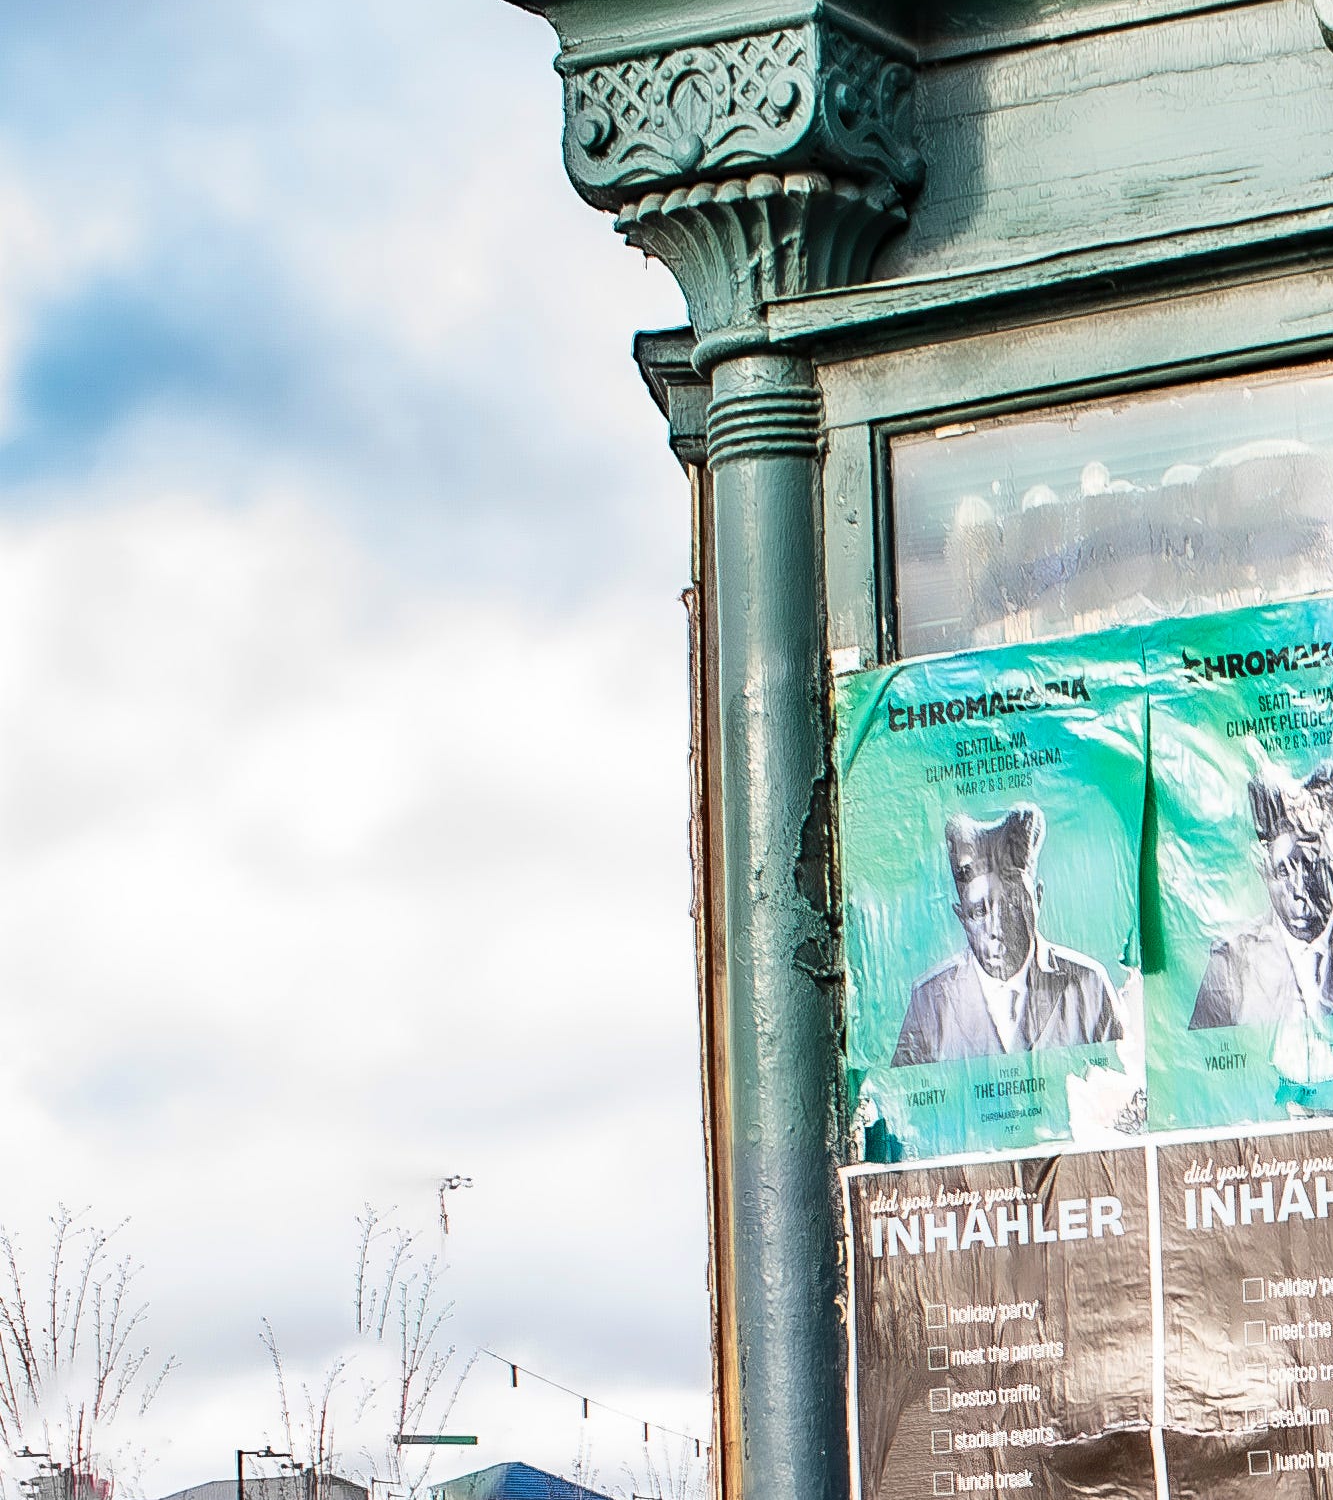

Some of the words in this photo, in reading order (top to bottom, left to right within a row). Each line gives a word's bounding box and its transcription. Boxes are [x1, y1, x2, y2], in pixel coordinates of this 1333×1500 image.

[1227, 716, 1278, 738] CLIMATE
[1280, 711, 1326, 733] PLEDGE
[956, 737, 1006, 758] SEATTLE,
[1009, 731, 1028, 749] WA
[926, 763, 974, 784] CLIMATE
[977, 755, 1020, 775] PLEDGE
[1022, 747, 1062, 767] ARENA
[957, 781, 978, 796] MAR
[980, 780, 987, 793] 2
[1009, 772, 1033, 789] 2025
[1205, 1053, 1247, 1072] YACHTY
[906, 1089, 946, 1107] YACHTY
[974, 1081, 995, 1099] THE
[997, 1077, 1046, 1097] CREATOR
[1184, 1158, 1213, 1184] did
[1217, 1163, 1248, 1190] you
[1251, 1153, 1300, 1182] bring
[870, 1188, 899, 1214] did
[901, 1196, 933, 1219] you
[936, 1184, 981, 1213] bring
[871, 1195, 1126, 1258] INHAHLER
[1268, 1277, 1317, 1298] holiday
[950, 1306, 996, 1324] holiday
[1270, 1322, 1305, 1341] meet
[1308, 1320, 1332, 1338] the
[952, 1347, 986, 1366] meet
[988, 1345, 1010, 1362] the
[1012, 1341, 1064, 1363] parents
[1270, 1364, 1317, 1383] costco
[952, 1389, 997, 1408] costco
[998, 1384, 1040, 1404] traffic
[1271, 1406, 1330, 1428] stadium
[954, 1430, 1007, 1450] stadium
[1010, 1425, 1054, 1447] events
[1276, 1452, 1315, 1471] lunch
[956, 1472, 994, 1491] lunch
[995, 1469, 1034, 1489] break
